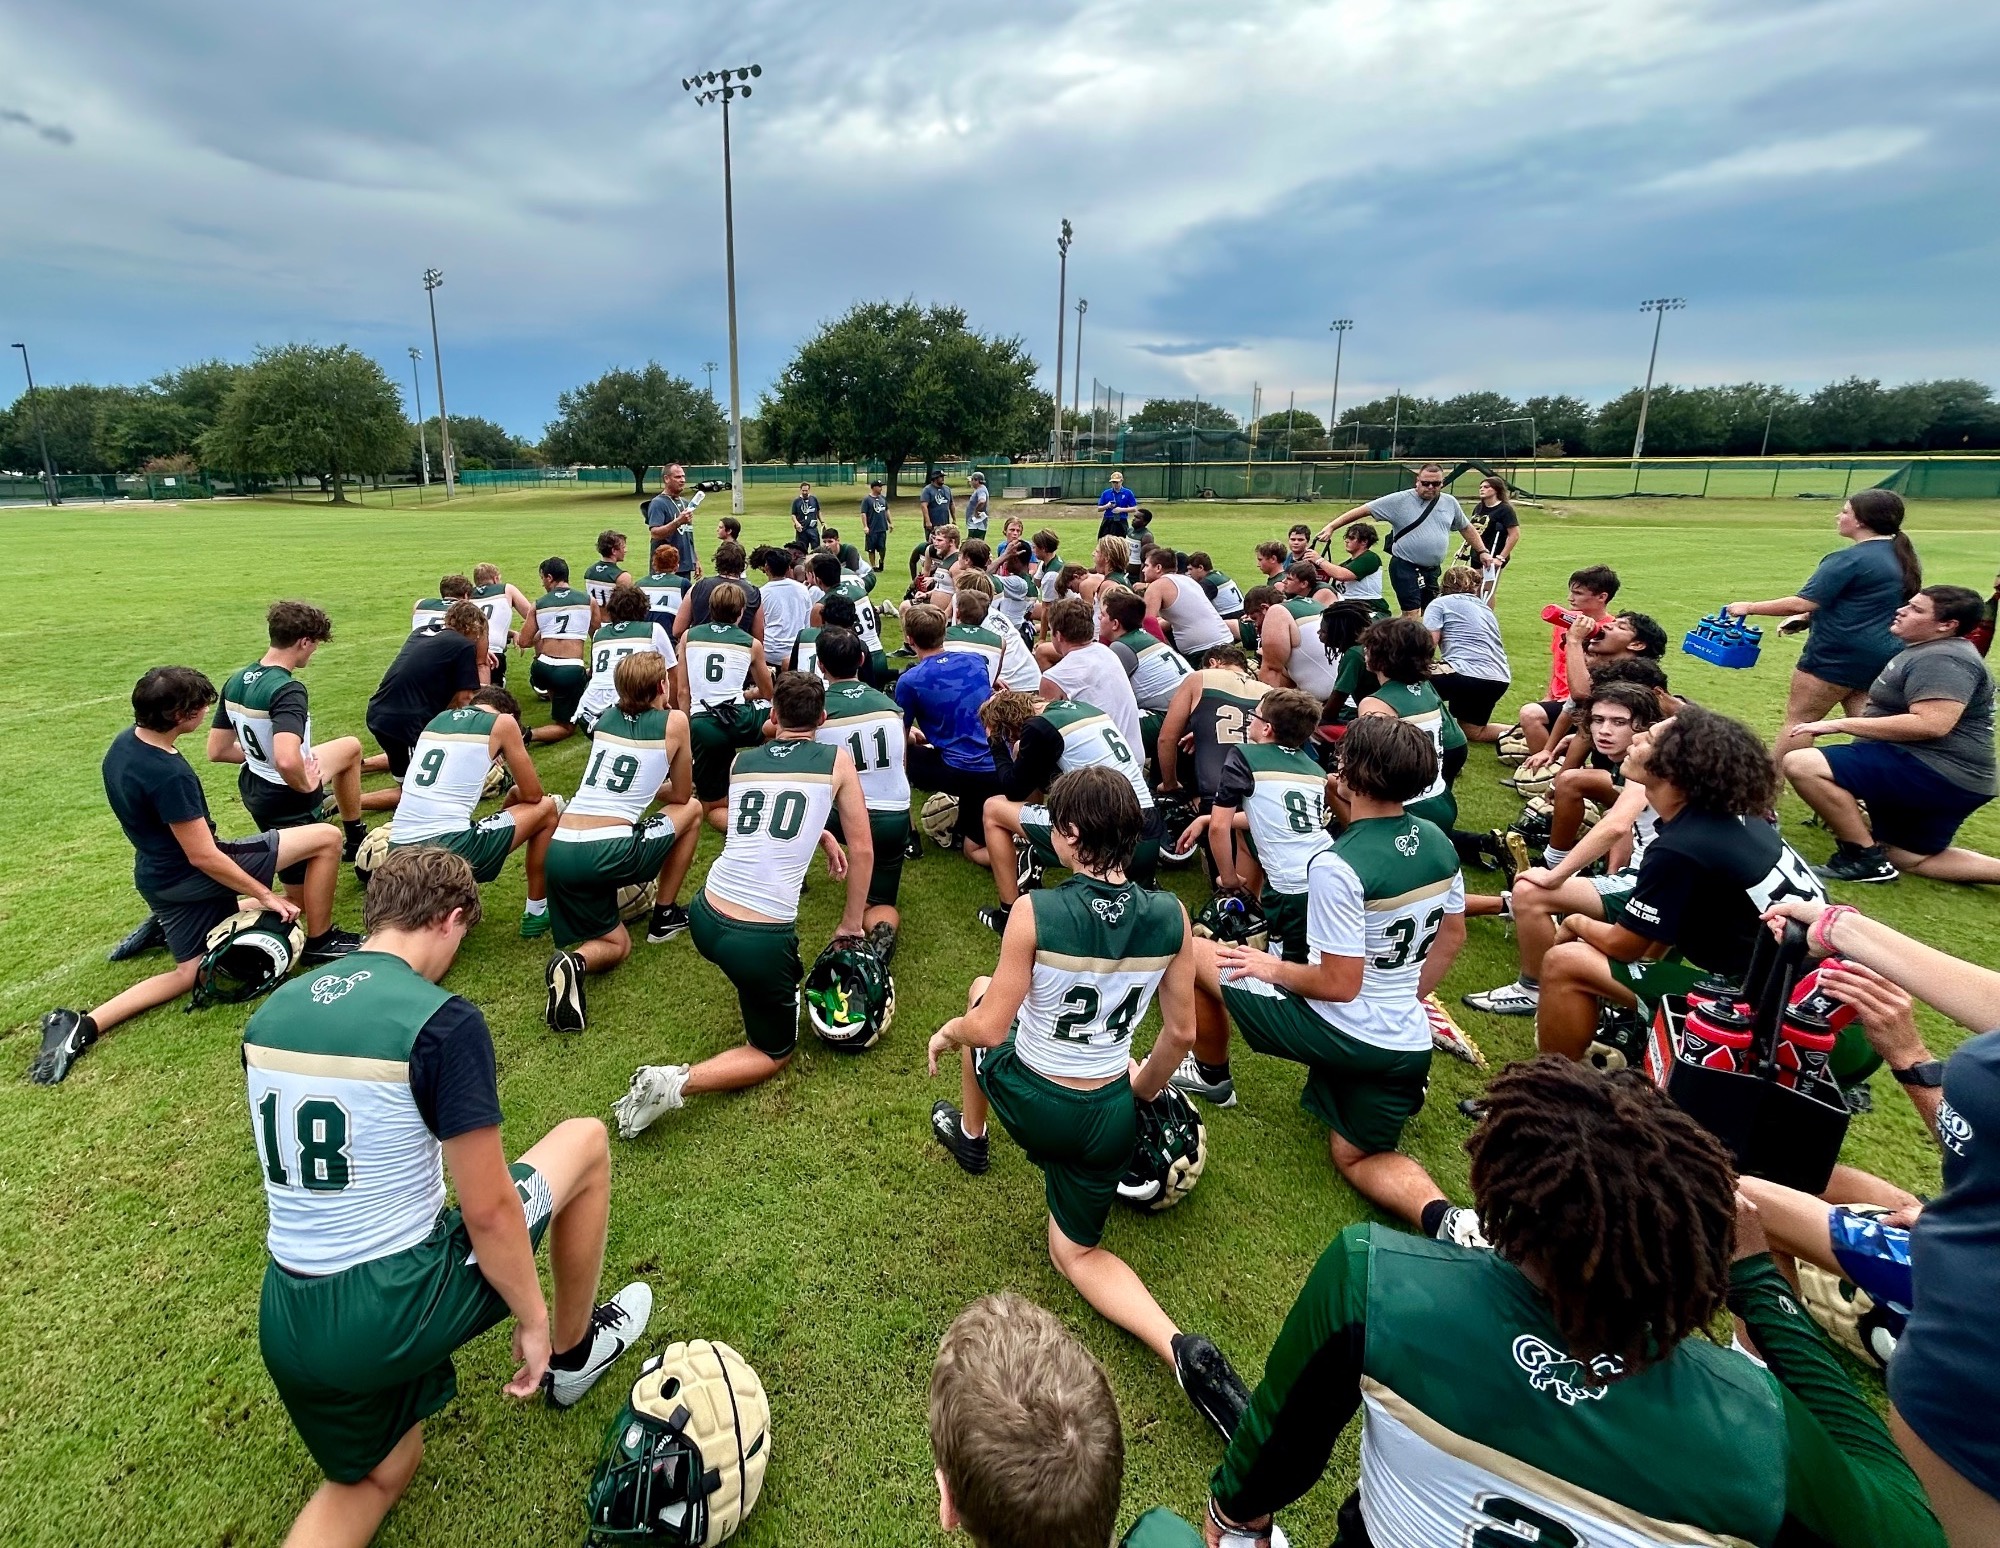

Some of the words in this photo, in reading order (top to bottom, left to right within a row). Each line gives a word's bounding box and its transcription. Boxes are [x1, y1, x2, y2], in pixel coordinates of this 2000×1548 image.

[554, 613, 571, 635] 7
[705, 653, 725, 683] 6
[1162, 651, 1188, 676] 7
[845, 726, 892, 770] 11
[1100, 726, 1130, 763] 6
[416, 747, 446, 788] 9
[584, 749, 641, 794] 19
[735, 789, 809, 841] 80
[259, 937, 287, 962] BUFFALO
[1371, 904, 1446, 969] 32
[1050, 982, 1147, 1046] 24
[257, 1087, 355, 1193] 18
